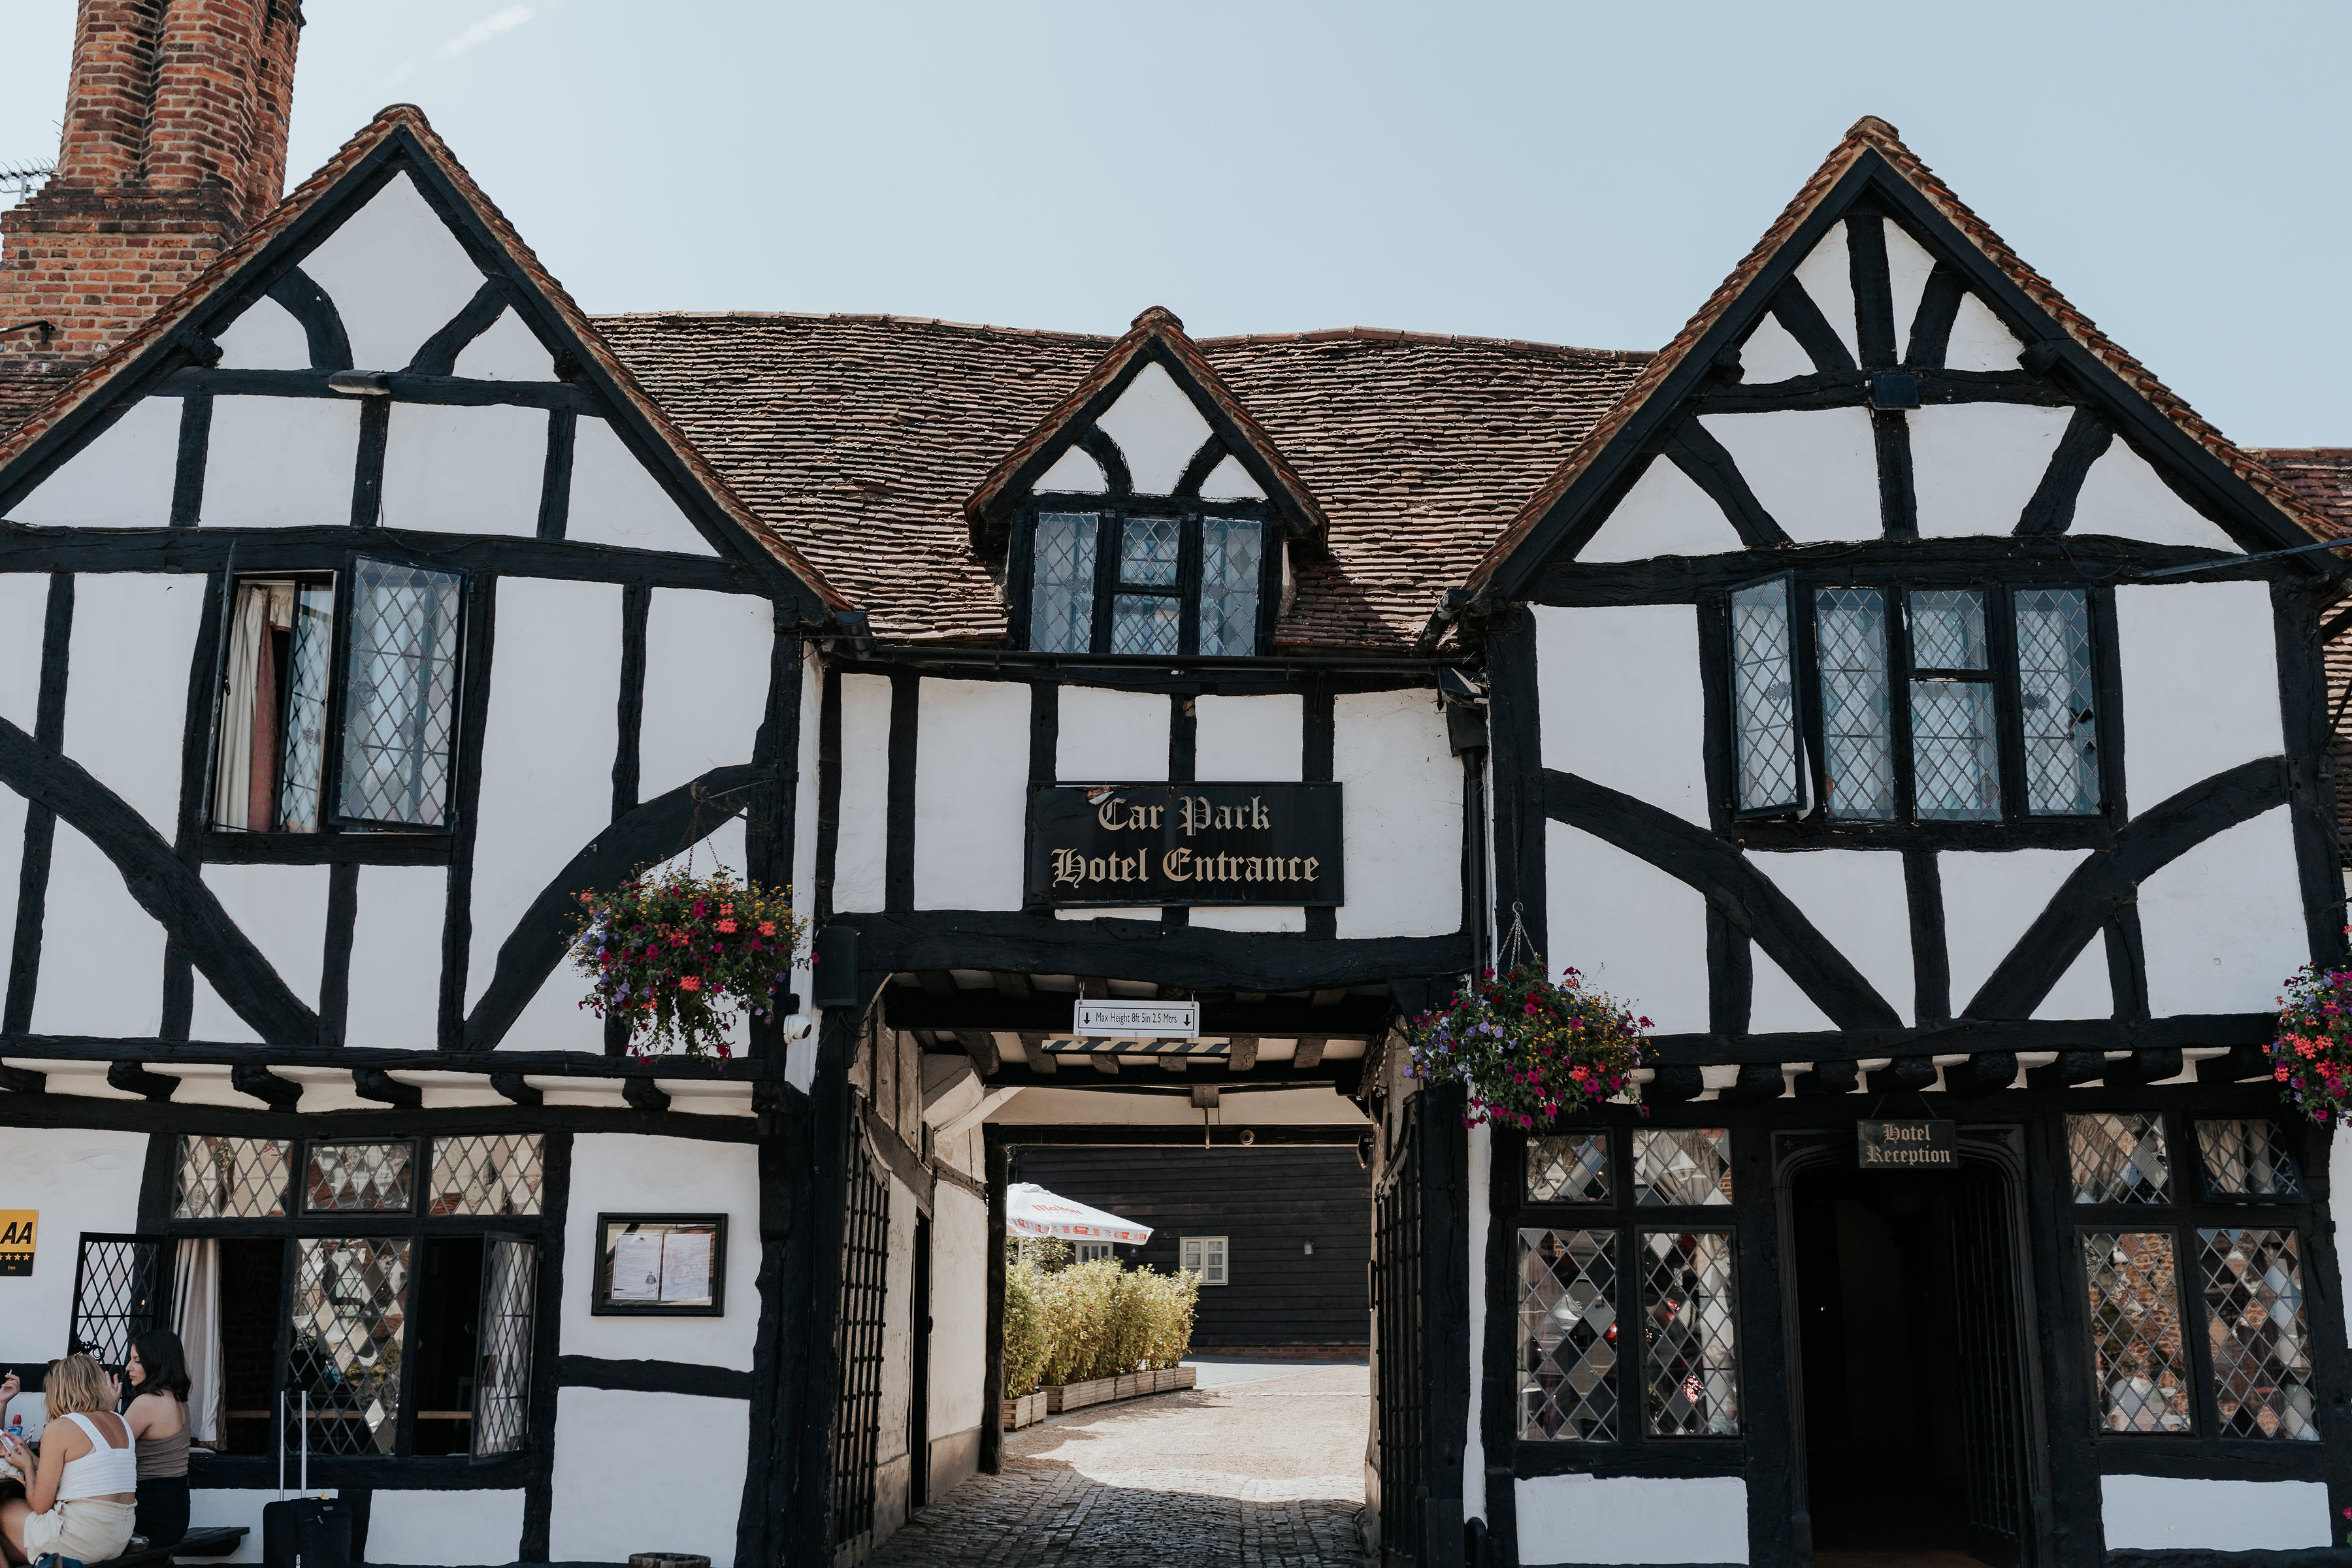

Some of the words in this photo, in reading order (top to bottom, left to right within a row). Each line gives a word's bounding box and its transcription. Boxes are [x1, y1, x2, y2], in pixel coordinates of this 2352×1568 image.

[1098, 796, 1165, 831] Car
[1176, 795, 1271, 836] Park
[1051, 847, 1150, 889] Hotel
[1162, 847, 1320, 883] Entrance
[1096, 1012, 1109, 1022] Max
[1110, 1012, 1130, 1026] Height
[1132, 1012, 1140, 1023] 8ft
[1141, 1013, 1151, 1023] 5in
[1152, 1013, 1162, 1024] 2.5
[1163, 1013, 1177, 1024] Mtrs
[1882, 1123, 1931, 1144] Hotel
[1866, 1145, 1951, 1166] Reception
[0, 1222, 33, 1245] AA
